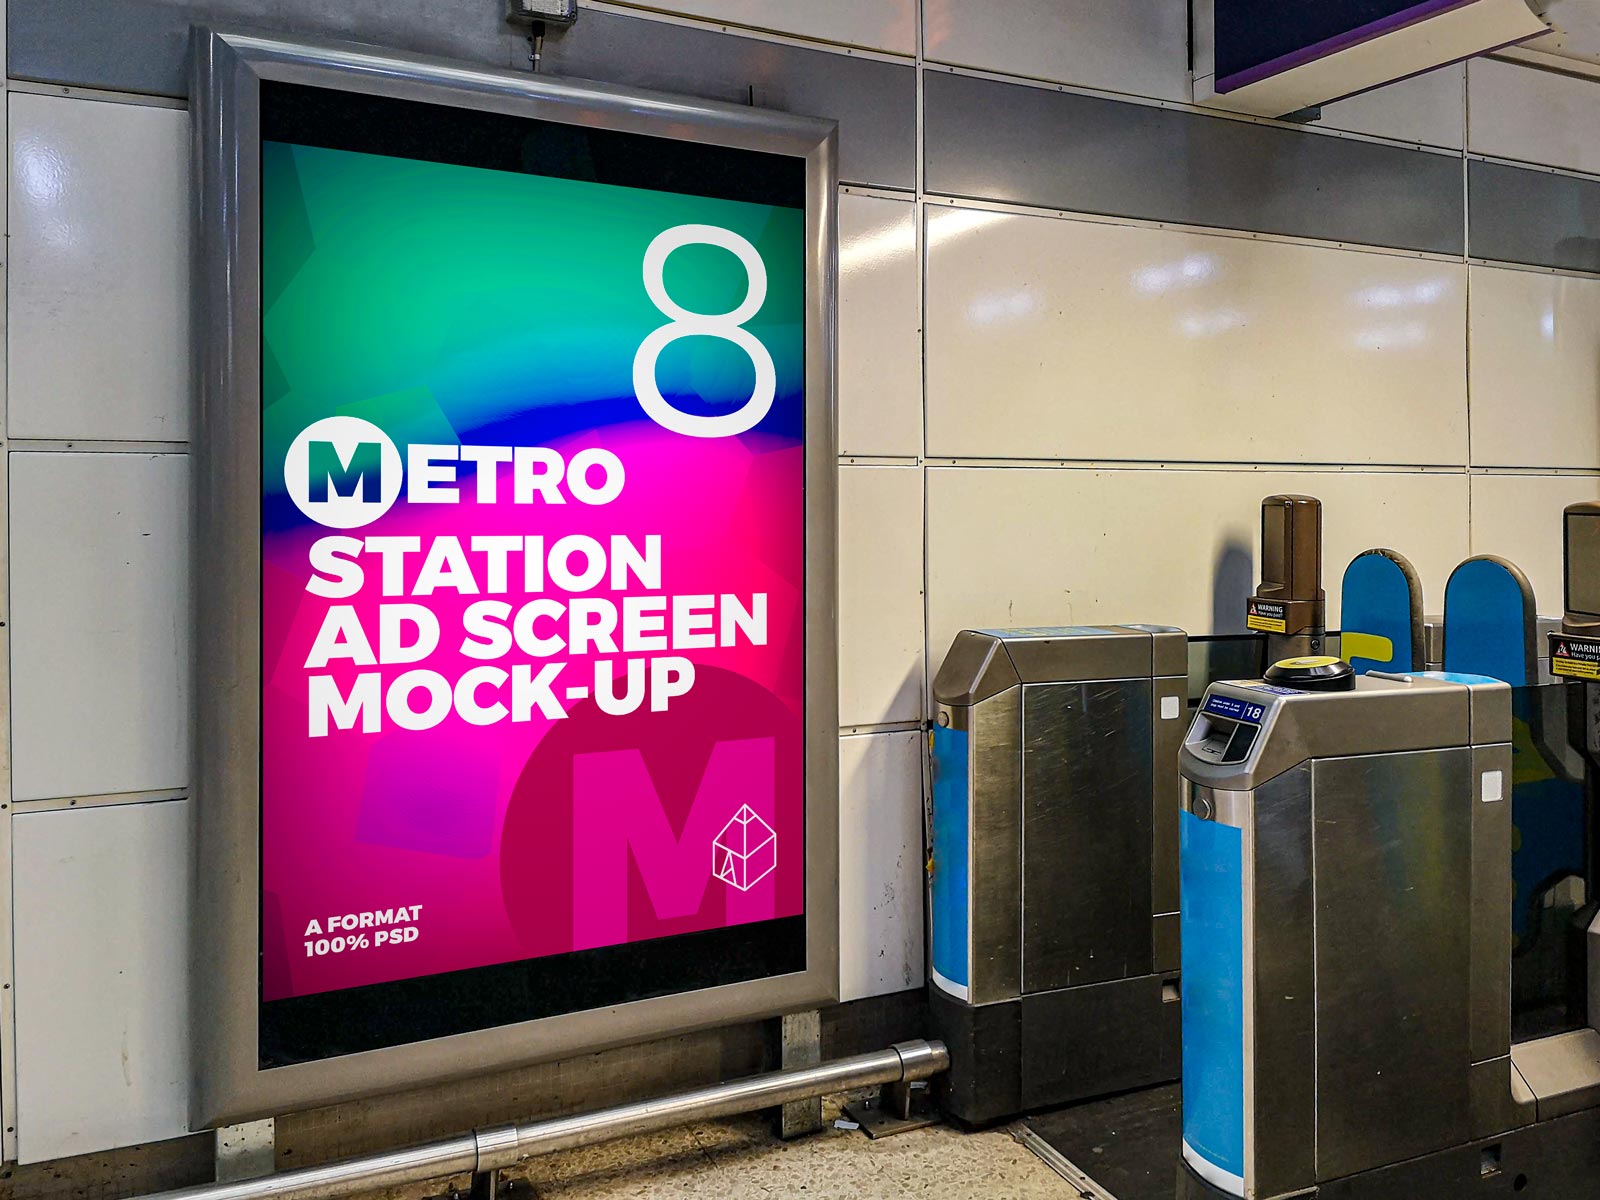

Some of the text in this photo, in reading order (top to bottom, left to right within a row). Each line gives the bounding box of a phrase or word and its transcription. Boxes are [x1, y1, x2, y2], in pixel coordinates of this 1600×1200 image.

[633, 223, 777, 438] 8
[305, 439, 626, 506] METRO
[305, 534, 662, 599] STATION
[304, 592, 768, 669] AD SCREEN
[1257, 604, 1283, 613] WARNING
[308, 656, 696, 738] MOCK-UP
[1247, 706, 1261, 719] 18
[304, 904, 423, 936] A FORMAT
[304, 926, 419, 957] 100% PSD
